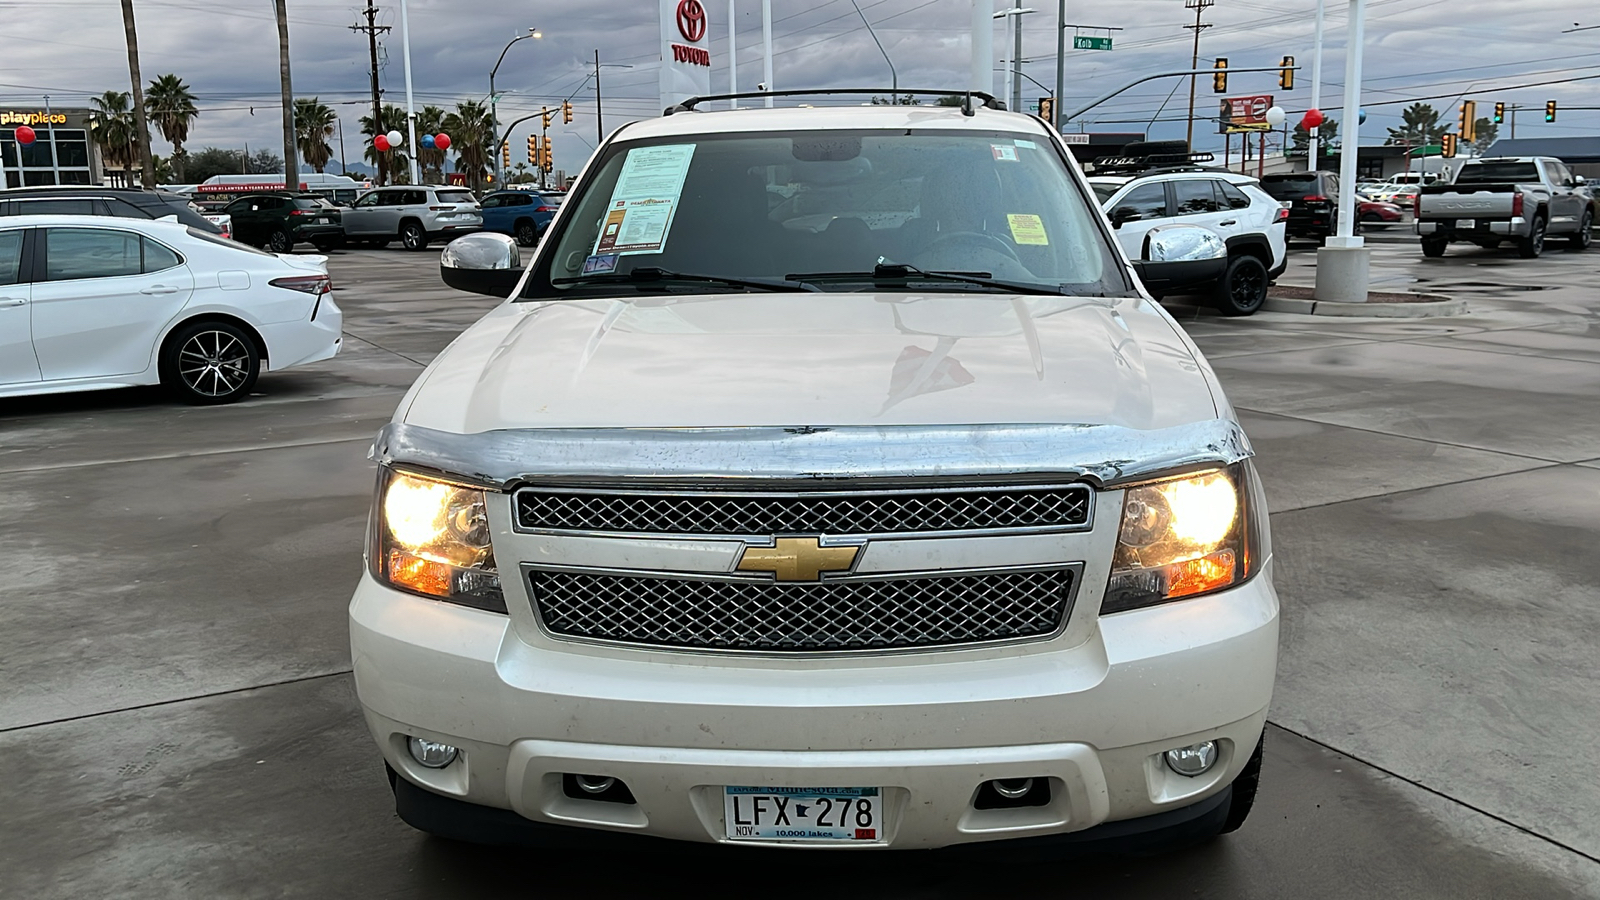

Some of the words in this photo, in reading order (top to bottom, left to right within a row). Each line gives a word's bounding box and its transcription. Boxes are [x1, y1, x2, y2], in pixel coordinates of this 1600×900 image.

[1077, 38, 1092, 48] Kolb
[671, 44, 710, 67] TOYOTA
[0, 111, 67, 125] playplace
[206, 193, 228, 201] CRASH
[732, 796, 791, 826] LFX
[815, 797, 873, 828] 278
[735, 826, 754, 836] NOV
